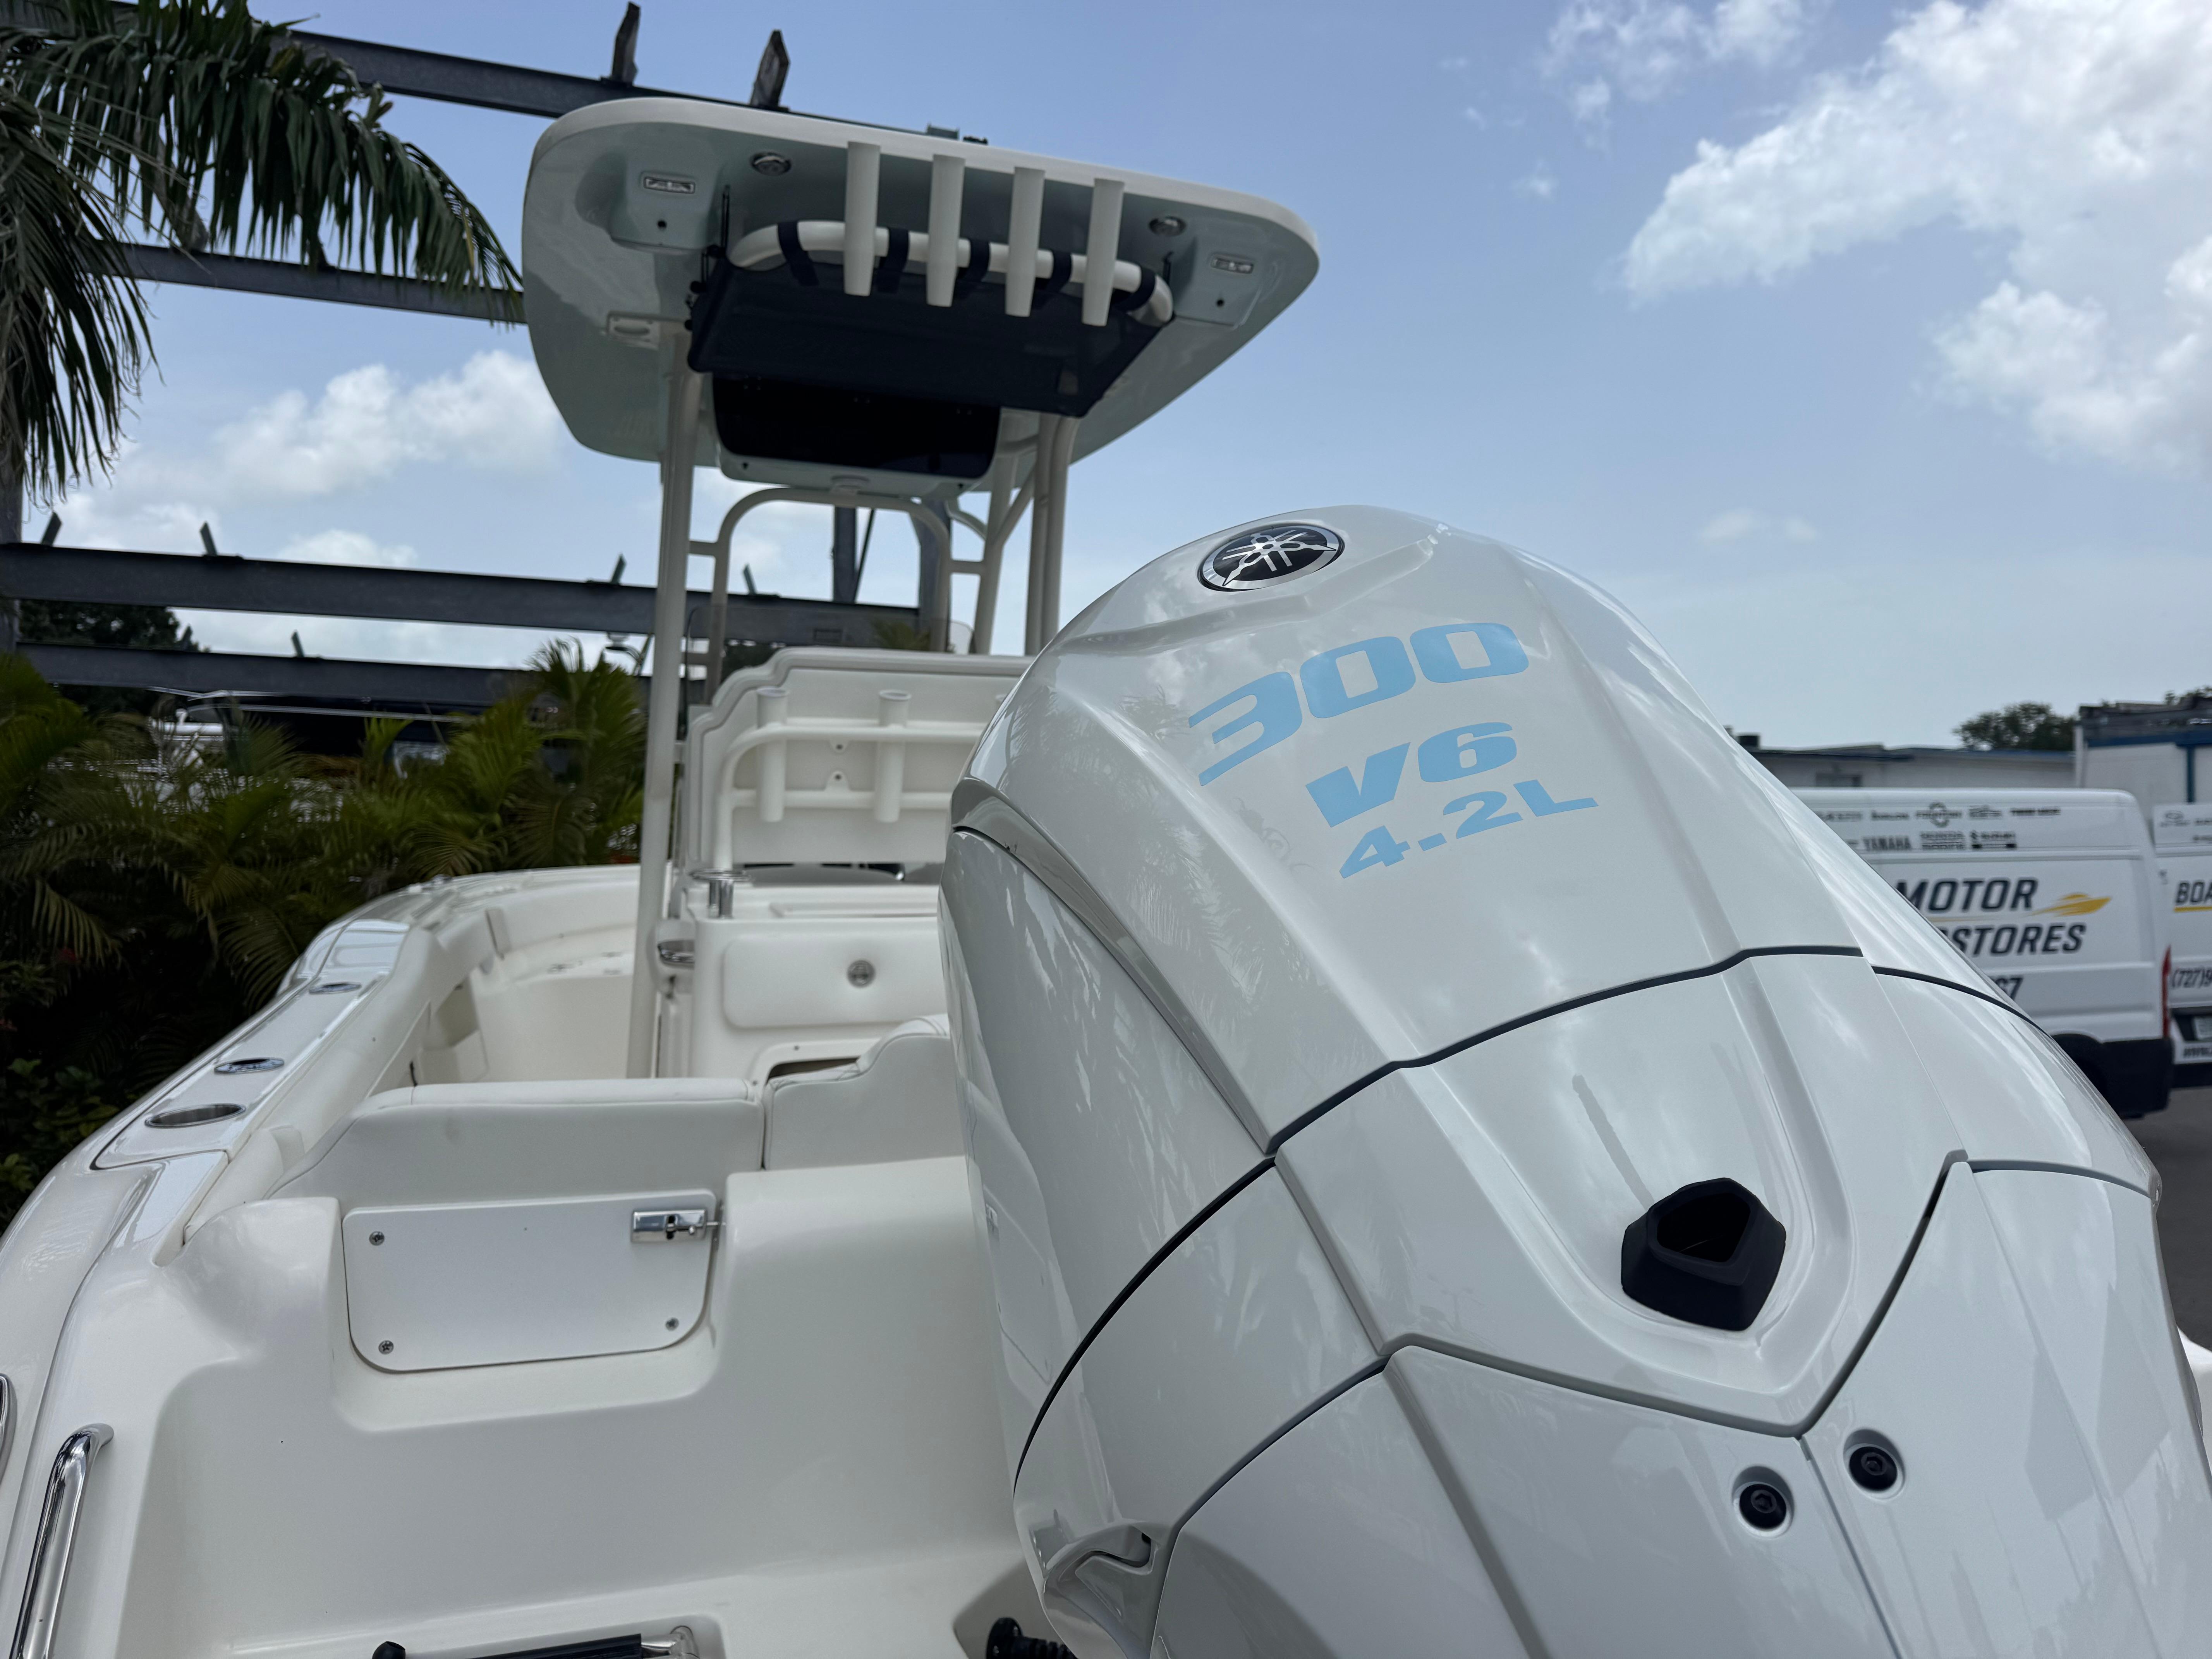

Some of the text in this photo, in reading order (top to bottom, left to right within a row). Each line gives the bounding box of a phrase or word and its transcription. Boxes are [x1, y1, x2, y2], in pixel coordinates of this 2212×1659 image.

[1188, 622, 1529, 786] 300
[1305, 722, 1517, 828] V6
[1340, 780, 1599, 879] 4.2L
[1896, 878, 2039, 913] MOTOR
[1937, 923, 2086, 957] STORES
